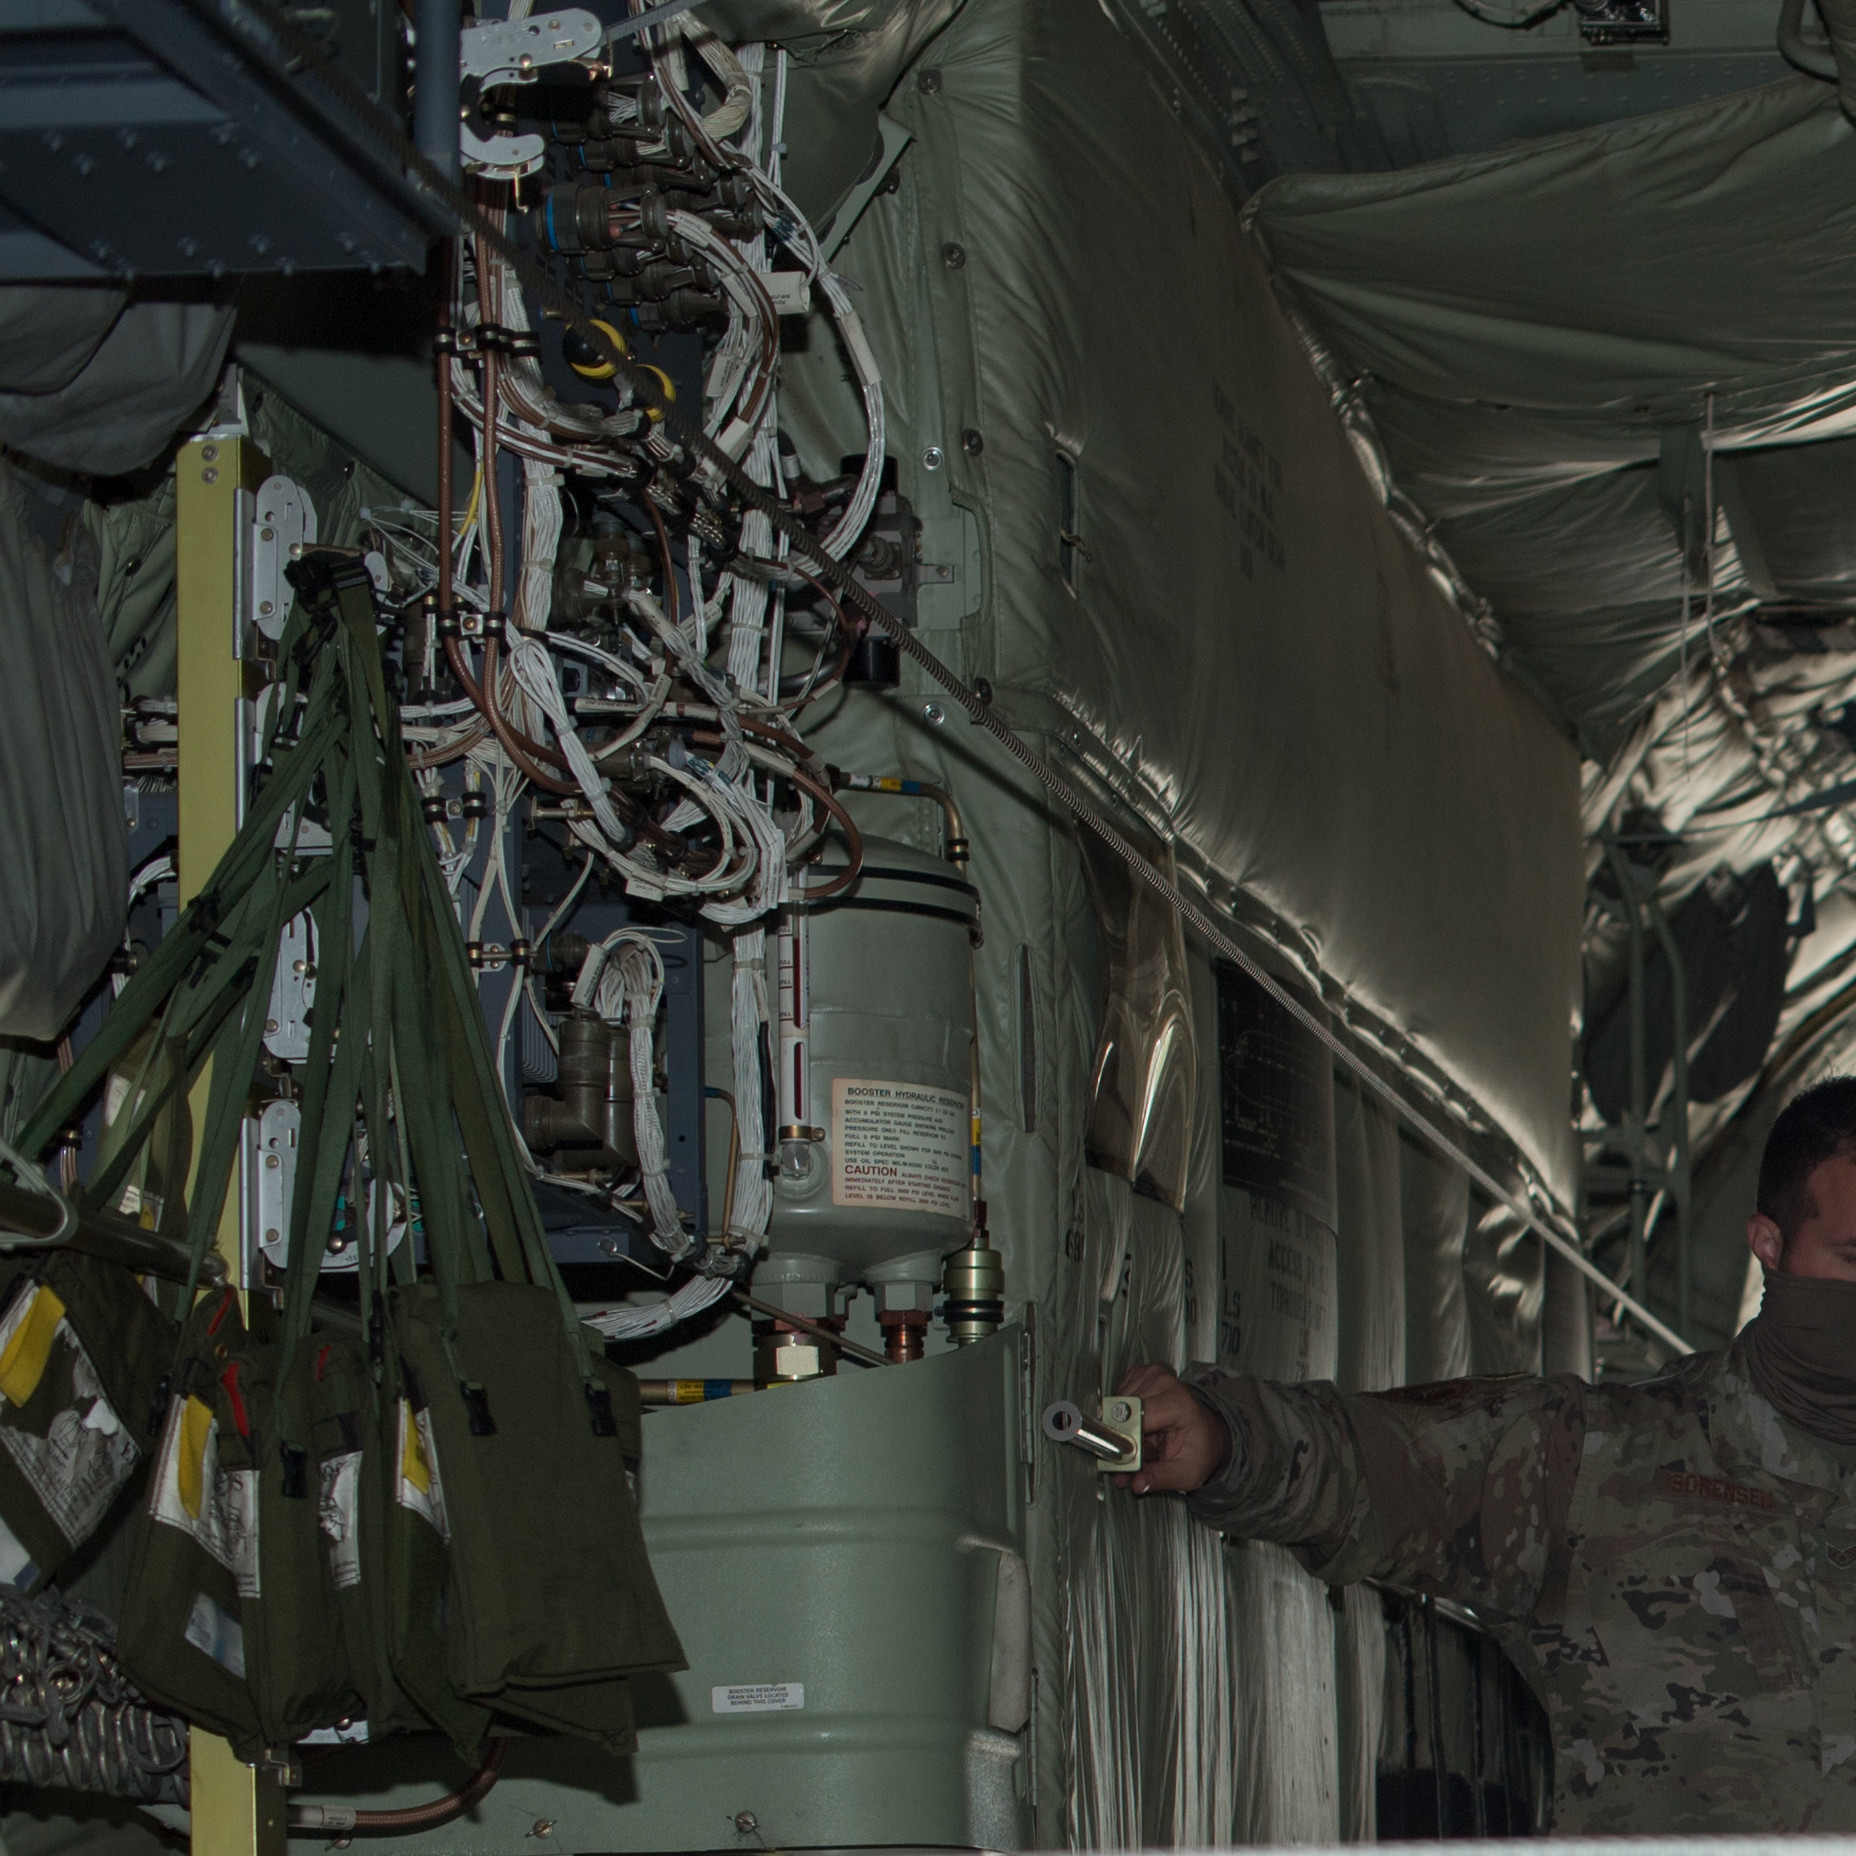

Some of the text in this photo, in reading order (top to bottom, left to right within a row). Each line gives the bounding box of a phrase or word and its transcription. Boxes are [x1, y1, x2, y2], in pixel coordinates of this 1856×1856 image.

[847, 1087, 891, 1097] BOOSTER
[895, 1090, 936, 1103] HYDRAULIC
[845, 1164, 898, 1177] CAUTION
[1670, 1474, 1773, 1510] SORENSEN
